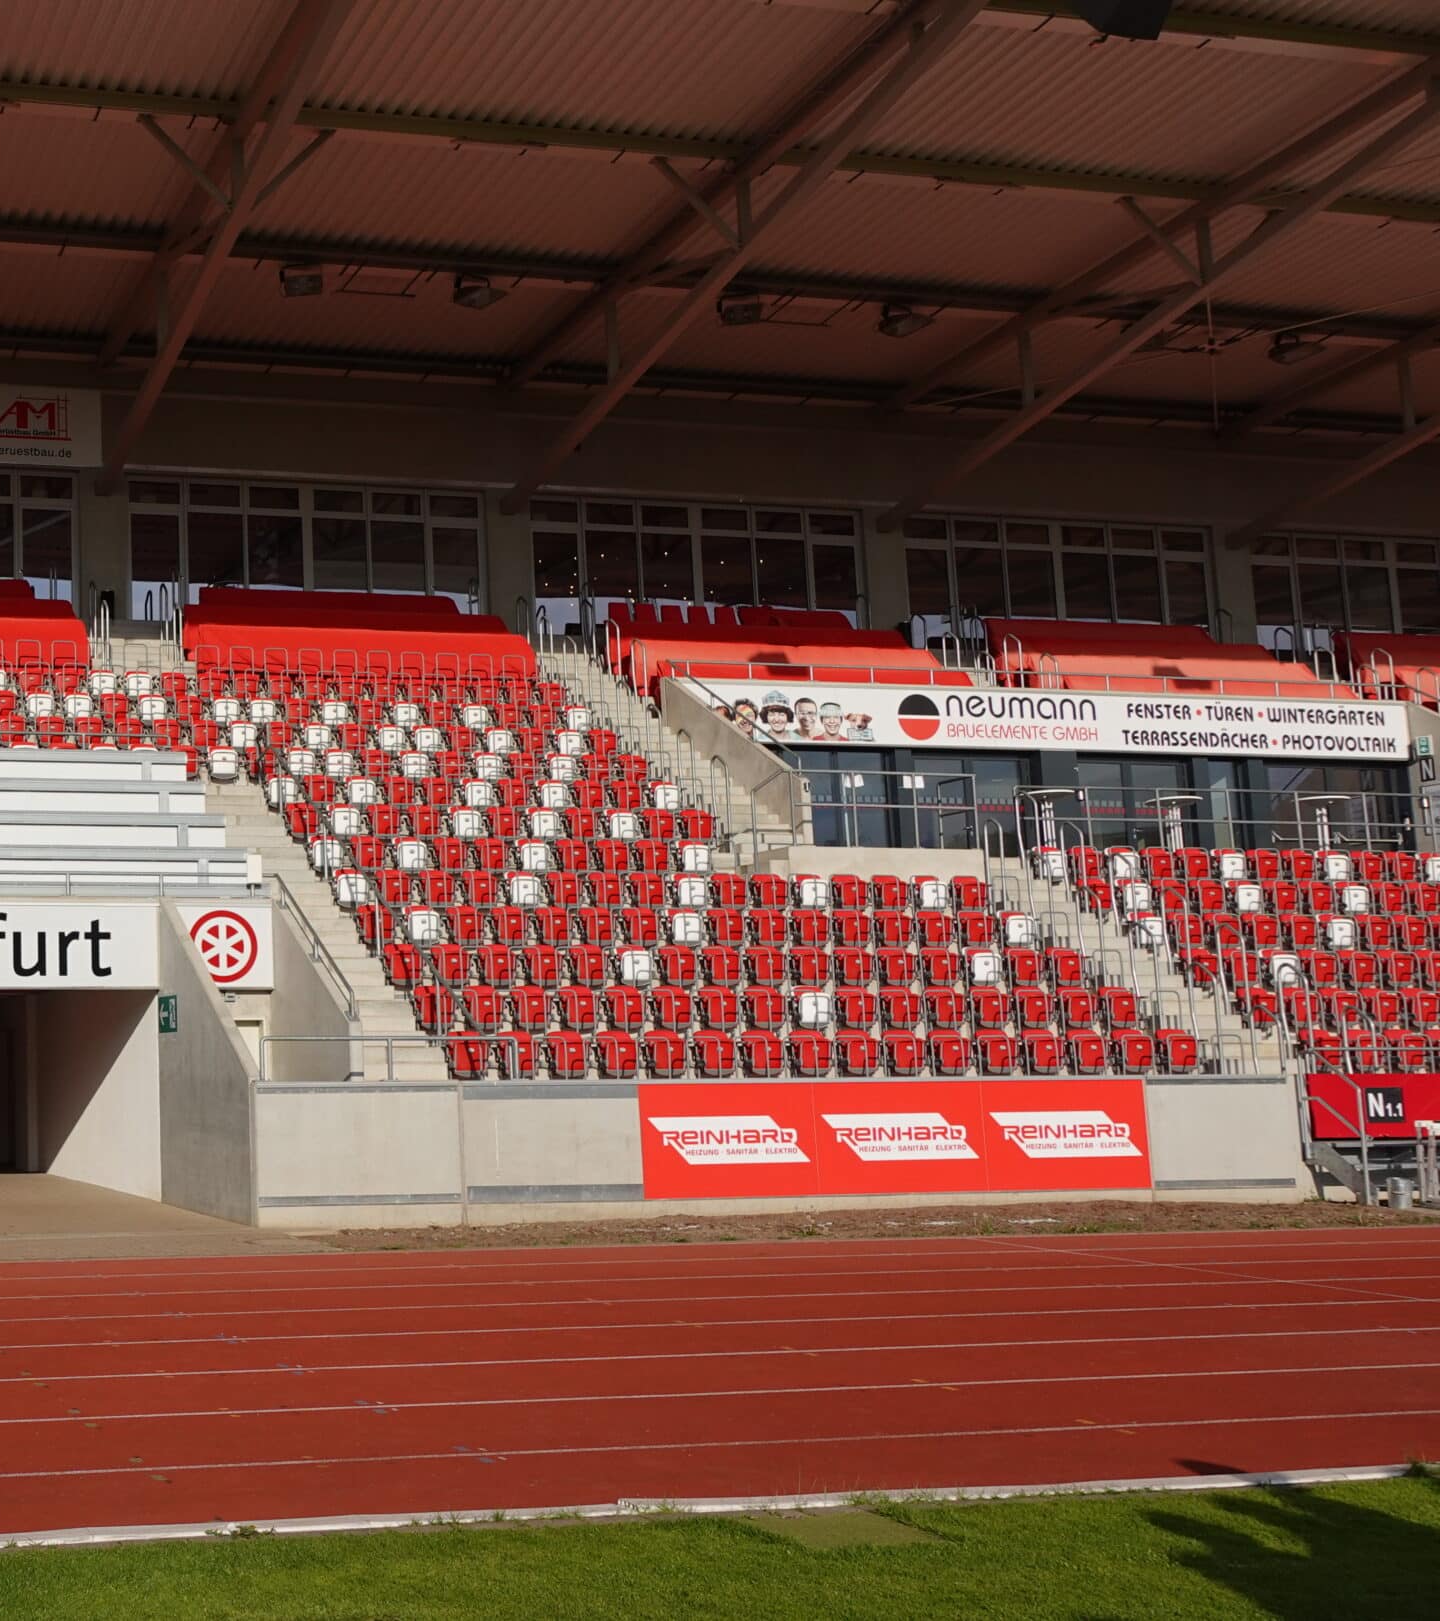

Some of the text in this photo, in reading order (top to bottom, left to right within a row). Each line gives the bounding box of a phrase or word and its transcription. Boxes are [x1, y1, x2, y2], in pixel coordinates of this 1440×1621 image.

[945, 694, 1097, 721] neumann
[1126, 701, 1385, 727] FENSTER TÜREN WINTERGÄRTEN
[947, 723, 1099, 742] BAUELEMENTE GMBH
[1121, 728, 1397, 753] TERRASSENDÄCHER PHOTOVOLTAIK
[685, 1146, 798, 1156] HEIZUNG SANITÄR ELEKTRO
[859, 1143, 967, 1153] HEIZUNG SANITÄR ELEKTRO
[1025, 1142, 1057, 1150] HEIZUNG
[1100, 1141, 1131, 1149] ELEKTRO
